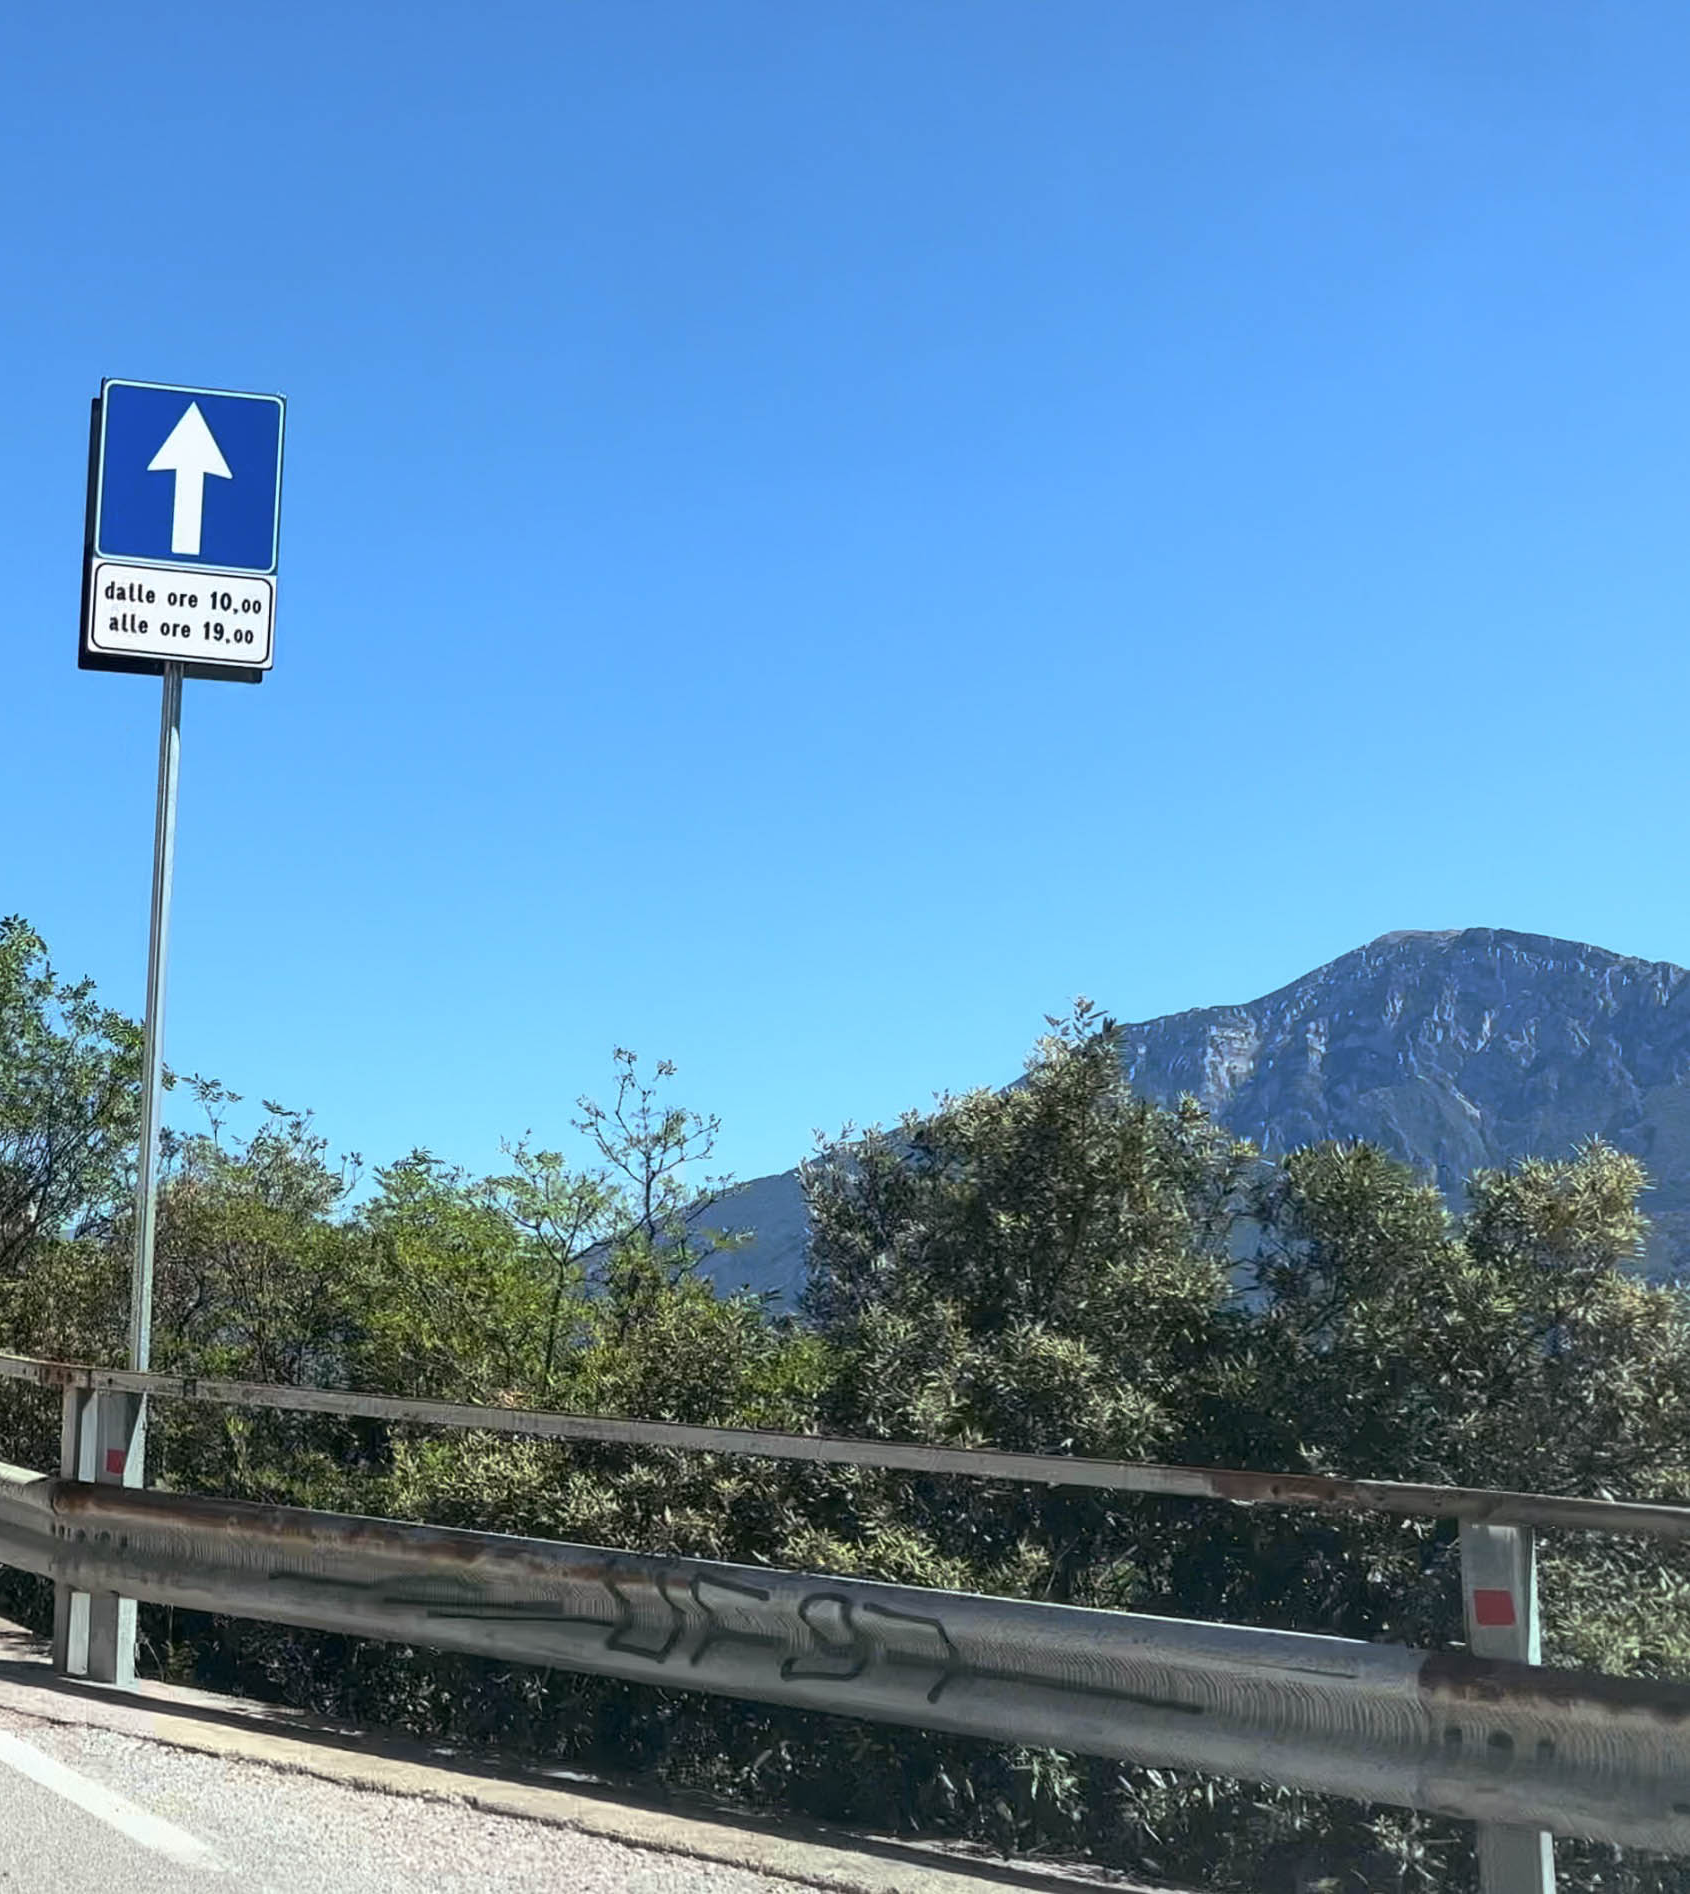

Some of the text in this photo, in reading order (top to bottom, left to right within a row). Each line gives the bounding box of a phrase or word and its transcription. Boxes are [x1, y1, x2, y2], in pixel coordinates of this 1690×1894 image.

[105, 581, 156, 604] dalle
[167, 592, 199, 609] ore
[109, 613, 149, 634] alle
[160, 622, 192, 639] ore
